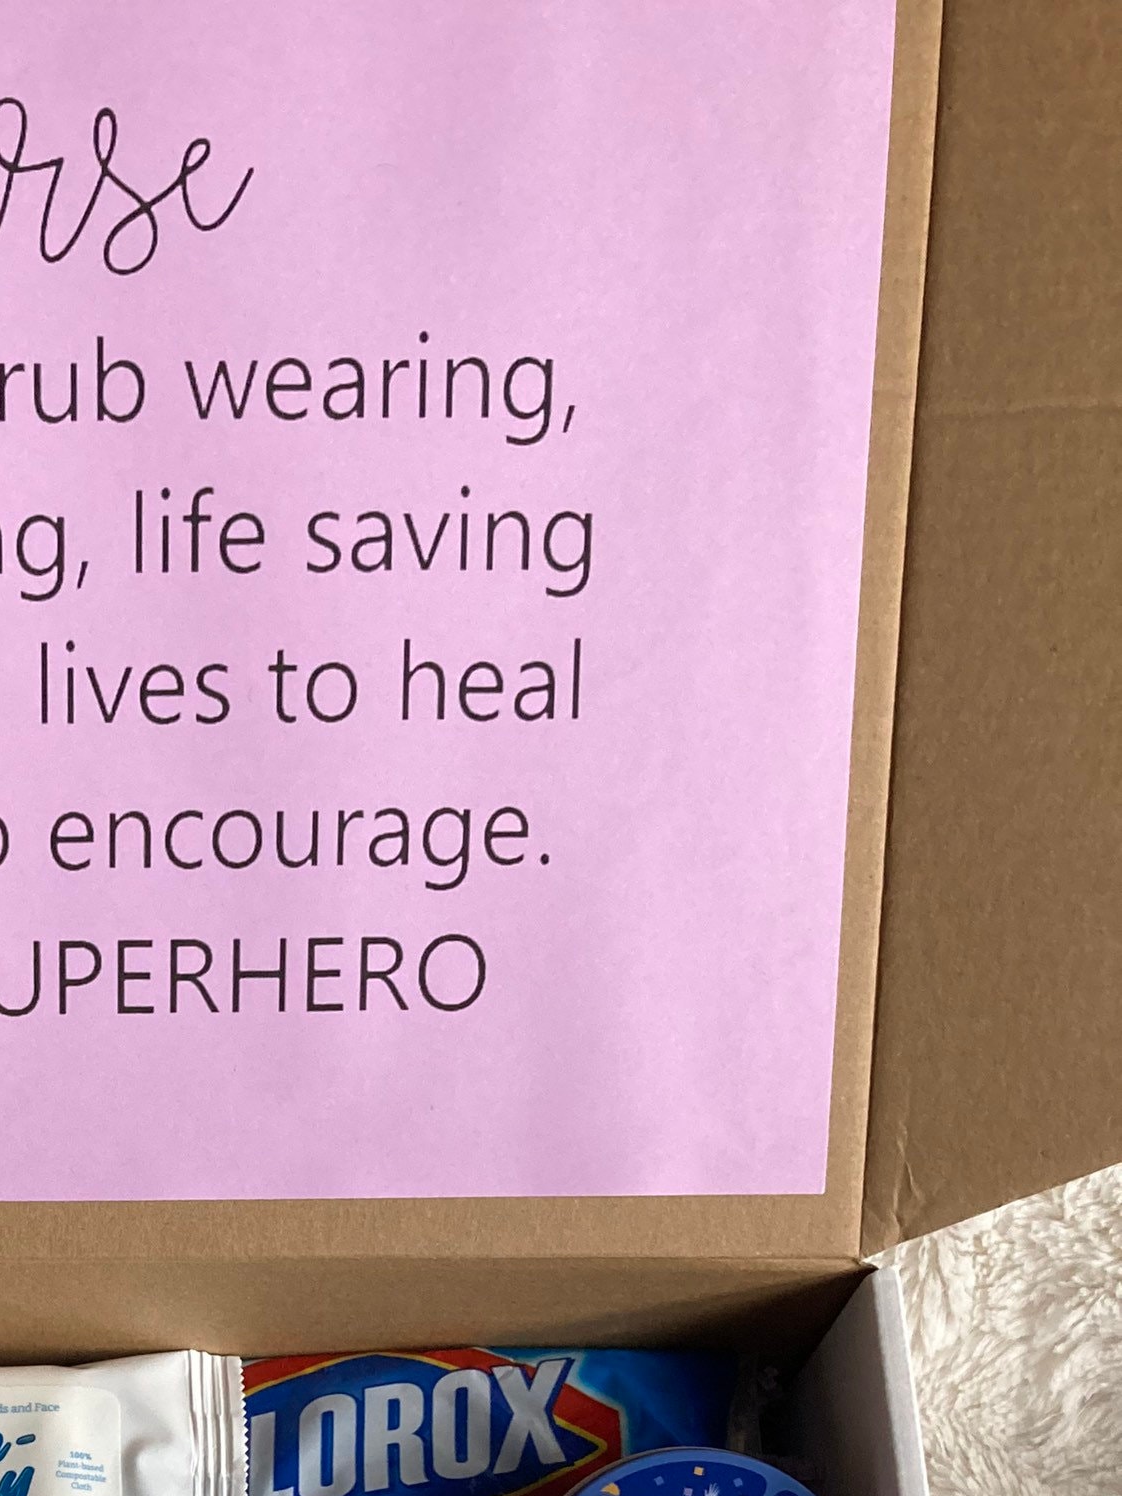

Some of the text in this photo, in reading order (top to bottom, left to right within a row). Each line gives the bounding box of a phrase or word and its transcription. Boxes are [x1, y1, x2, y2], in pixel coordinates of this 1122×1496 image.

[184, 331, 576, 447] wearing,
[135, 487, 265, 575] life
[306, 486, 593, 598] saving
[40, 640, 231, 726] lives
[267, 649, 358, 724] to
[401, 638, 582, 723] heal
[49, 807, 550, 892] encourage.
[10, 1402, 32, 1414] and
[34, 1402, 61, 1413] Face
